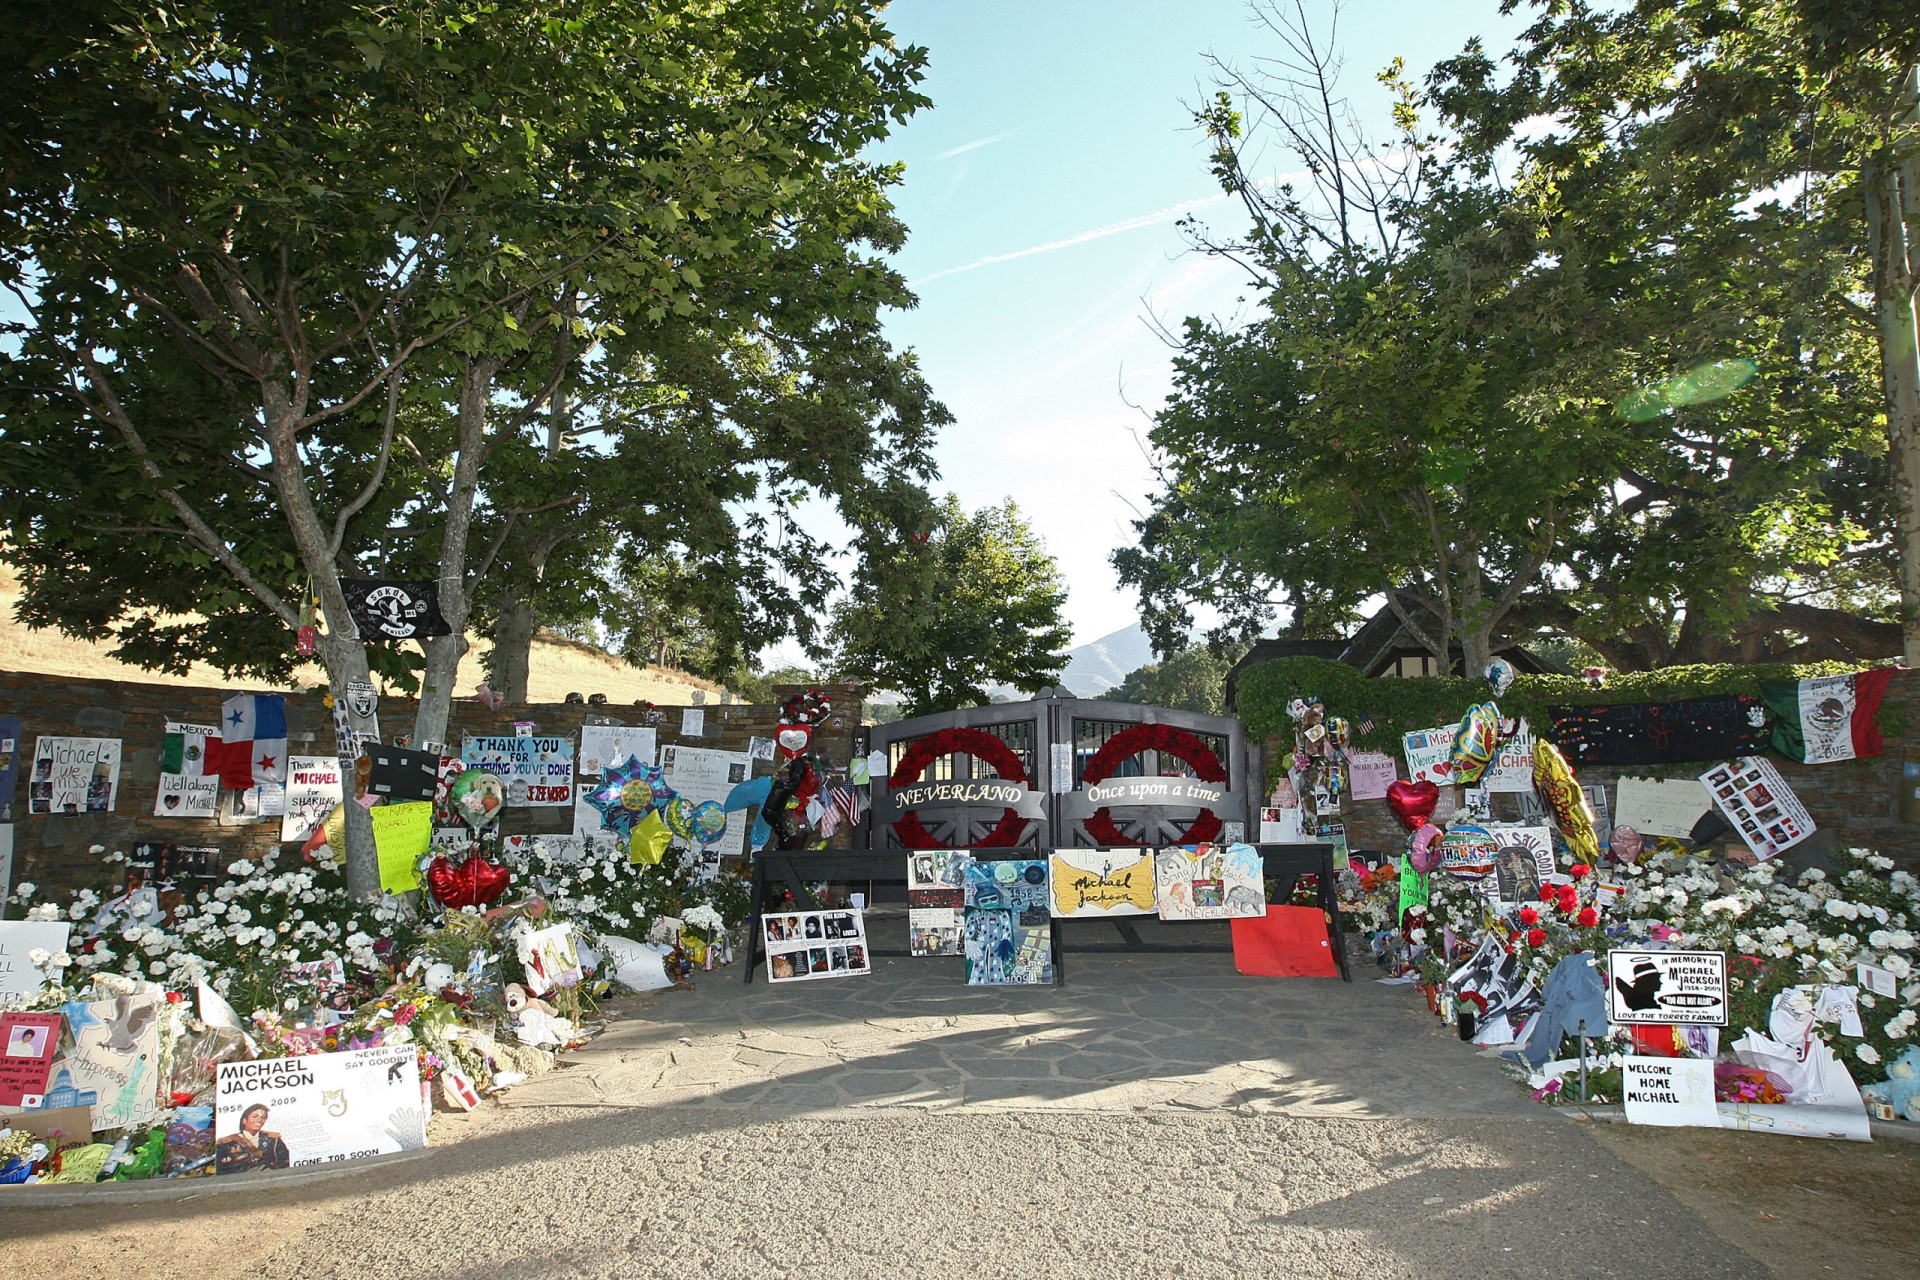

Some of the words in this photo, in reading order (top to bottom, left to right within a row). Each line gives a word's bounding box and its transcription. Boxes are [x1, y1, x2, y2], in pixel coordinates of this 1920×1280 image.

[179, 725, 214, 736] MEXICO
[1428, 730, 1454, 747] Mich
[475, 738, 526, 752] THANK
[532, 739, 559, 753] YOU
[510, 752, 529, 763] FOR
[1497, 754, 1535, 768] ICHAE
[60, 765, 81, 778] we
[291, 760, 316, 771] Thank
[547, 763, 572, 776] DONE
[53, 775, 87, 789] miss
[293, 772, 339, 785] MICHAEL
[188, 779, 217, 794] always
[307, 787, 320, 796] for
[1088, 785, 1125, 802] Once
[1129, 783, 1168, 801] upon
[1172, 785, 1183, 796] a
[1186, 784, 1221, 802] time
[291, 796, 336, 807] SHARING
[895, 783, 1022, 809] NEVERLAND
[288, 811, 308, 820] YOUR
[1625, 803, 1668, 818] LOVE
[1440, 845, 1491, 862] THANKS!
[1071, 872, 1132, 891] Michael
[1010, 888, 1033, 898] 1958
[1078, 890, 1134, 909] Jackson
[1185, 906, 1238, 919] NEVERLAND
[1661, 958, 1669, 966] IN
[1670, 956, 1707, 965] MEMORY
[1709, 958, 1718, 966] OF
[1668, 966, 1716, 981] MICHAEL
[1677, 975, 1721, 992] JACKSON
[1676, 996, 1687, 1006] ARE
[1687, 996, 1697, 1006] NOT
[1658, 1013, 1690, 1021] TORRES
[1691, 1014, 1722, 1022] FAMILY
[355, 1049, 389, 1059] NEVER
[394, 1045, 414, 1055] CAN
[73, 1047, 128, 1088] Happiness
[344, 1060, 364, 1070] SAY
[368, 1054, 416, 1067] GOODBYE
[220, 1059, 308, 1080] MICHAEL
[1628, 1064, 1672, 1076] WELCOME
[221, 1072, 314, 1095] JACKSON
[1639, 1078, 1671, 1089] HOME
[270, 1096, 297, 1107] 2009
[1627, 1091, 1680, 1104] MICHAEL
[218, 1104, 244, 1114] 1958
[293, 1157, 323, 1168] GONE
[327, 1153, 346, 1163] TOO
[350, 1148, 379, 1160] SOON
